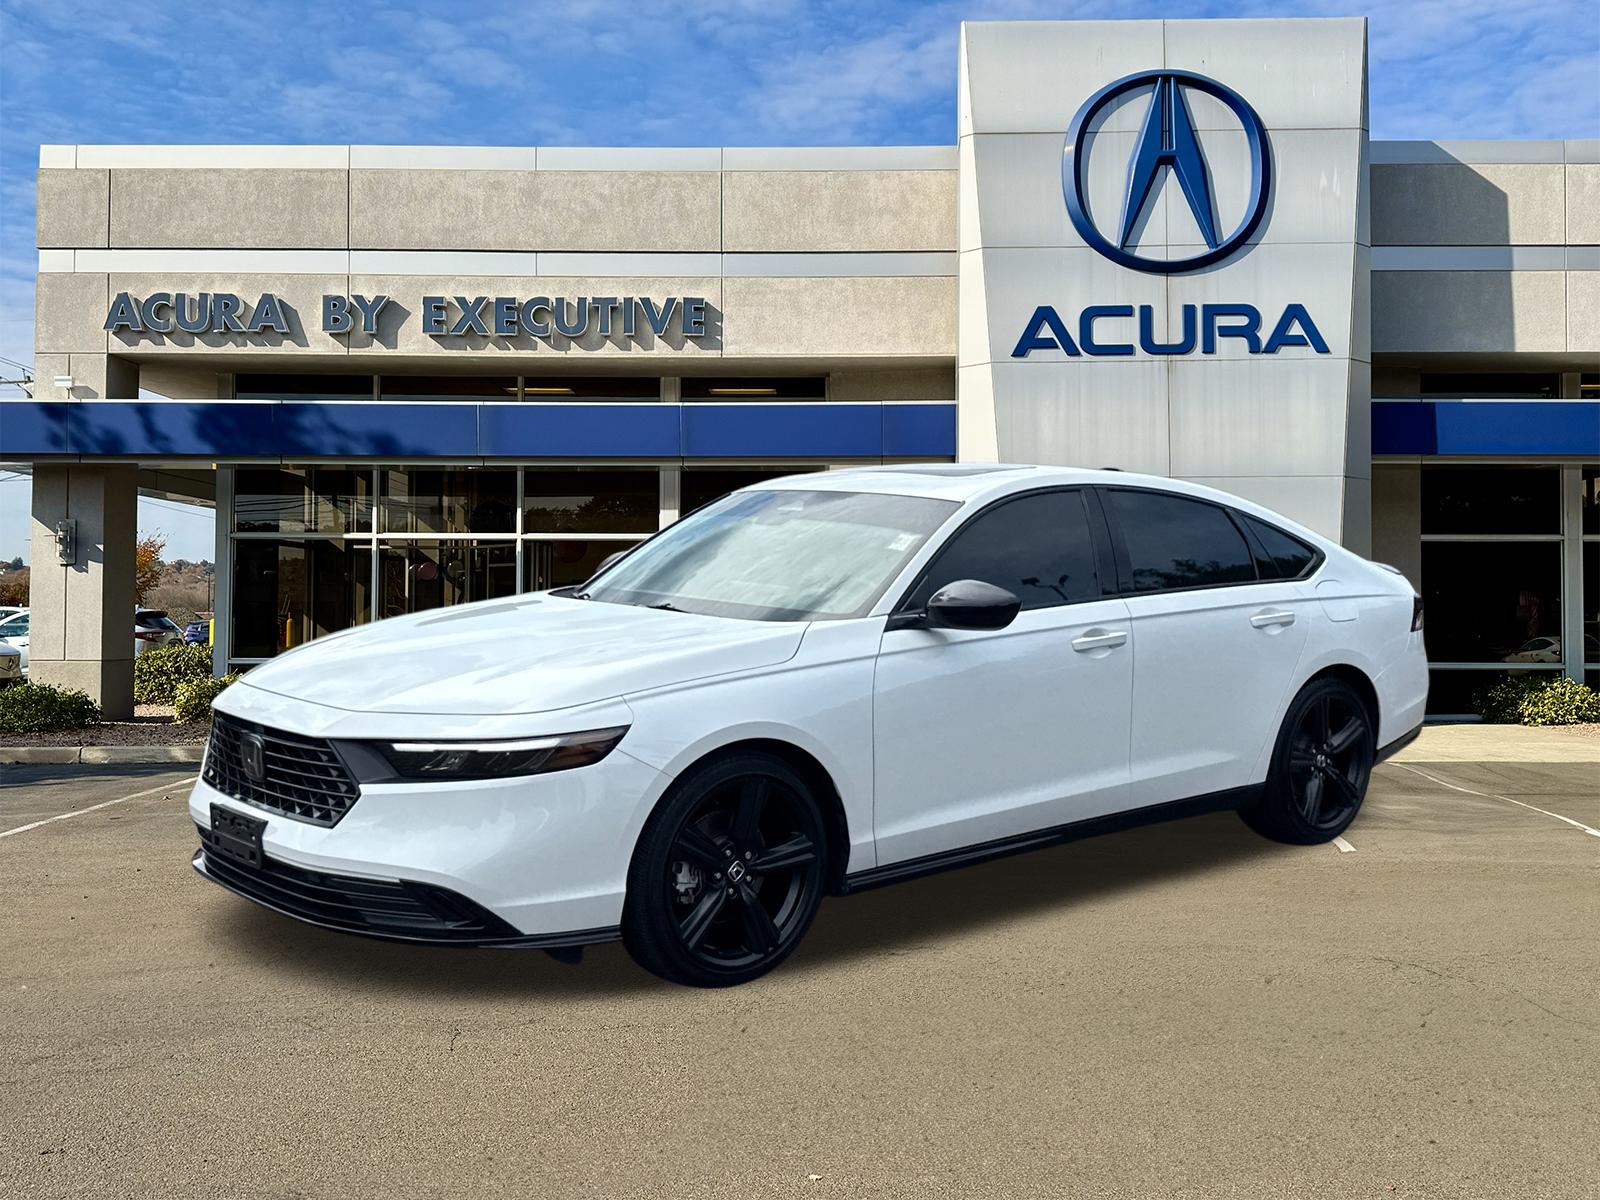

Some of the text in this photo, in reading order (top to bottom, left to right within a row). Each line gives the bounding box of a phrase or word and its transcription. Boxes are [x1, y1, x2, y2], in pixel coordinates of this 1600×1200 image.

[104, 292, 706, 337] ACURA BY EXECUTIVE
[1011, 303, 1332, 357] ACURA
